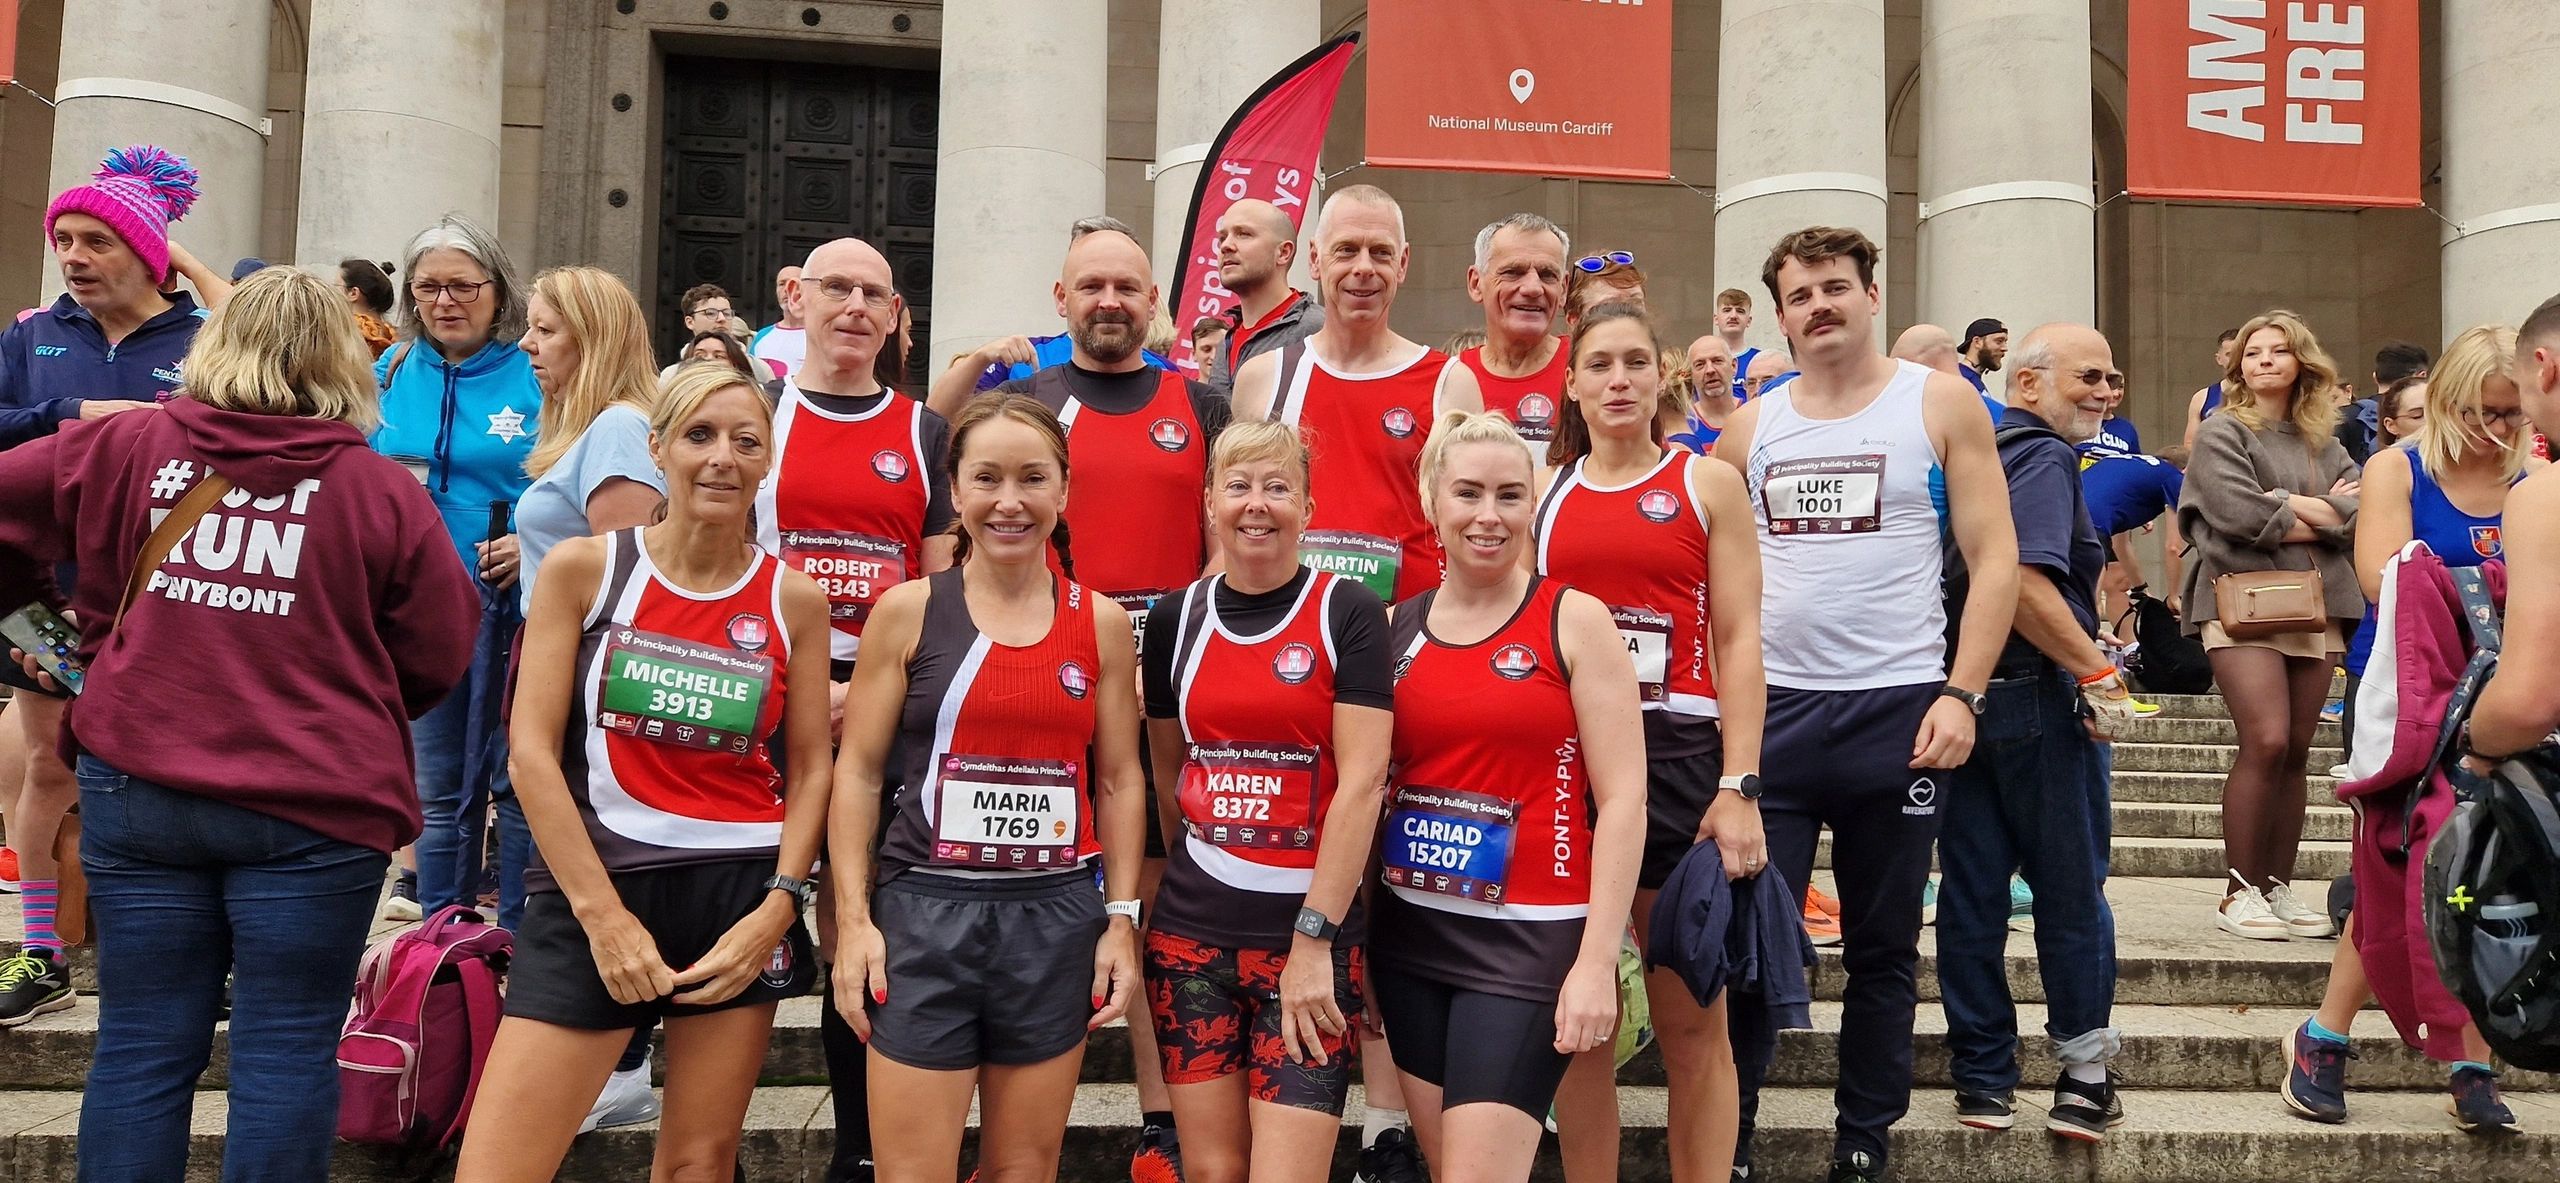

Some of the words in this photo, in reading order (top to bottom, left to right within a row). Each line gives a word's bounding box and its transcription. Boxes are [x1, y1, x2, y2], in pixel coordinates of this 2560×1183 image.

[1428, 114, 1490, 131] National
[1494, 118, 1558, 133] Museum
[1562, 120, 1614, 136] Cardiff
[1221, 159, 1252, 201] of
[2102, 432, 2130, 452] CLUB
[1781, 463, 1819, 474] Principality
[1820, 461, 1850, 469] Building
[1852, 460, 1880, 469] Society
[1797, 480, 1844, 494] LUKE
[1797, 498, 1842, 513] 1001
[799, 535, 843, 548] Principality
[844, 538, 874, 552] Building
[874, 542, 900, 556] Society
[1304, 534, 1341, 545] Principality
[1342, 536, 1371, 549] Building
[1372, 541, 1398, 553] Society
[804, 557, 883, 579] ROBERT
[1305, 554, 1379, 575] MARTIN
[816, 577, 871, 598] 8343
[1638, 614, 1667, 627] Society
[632, 637, 689, 657] Principality
[689, 648, 730, 666] Building
[730, 657, 765, 673] Society
[622, 659, 750, 702] MICHELLE
[648, 689, 713, 721] 3913
[960, 761, 1006, 772] Cymdeithas
[1007, 764, 1039, 774] Adeiladu
[1200, 749, 1241, 760] Principality
[1242, 749, 1279, 761] Building
[1280, 751, 1313, 764] Society
[1207, 773, 1282, 796] KAREN
[973, 790, 1051, 813] MARIA
[1212, 796, 1270, 821] 8372
[1403, 792, 1443, 807] Principality
[1443, 797, 1479, 813] Building
[1479, 803, 1512, 819] Society
[982, 816, 1040, 839] 1769
[1403, 817, 1482, 847] CARIAD
[1407, 841, 1472, 871] 15207
